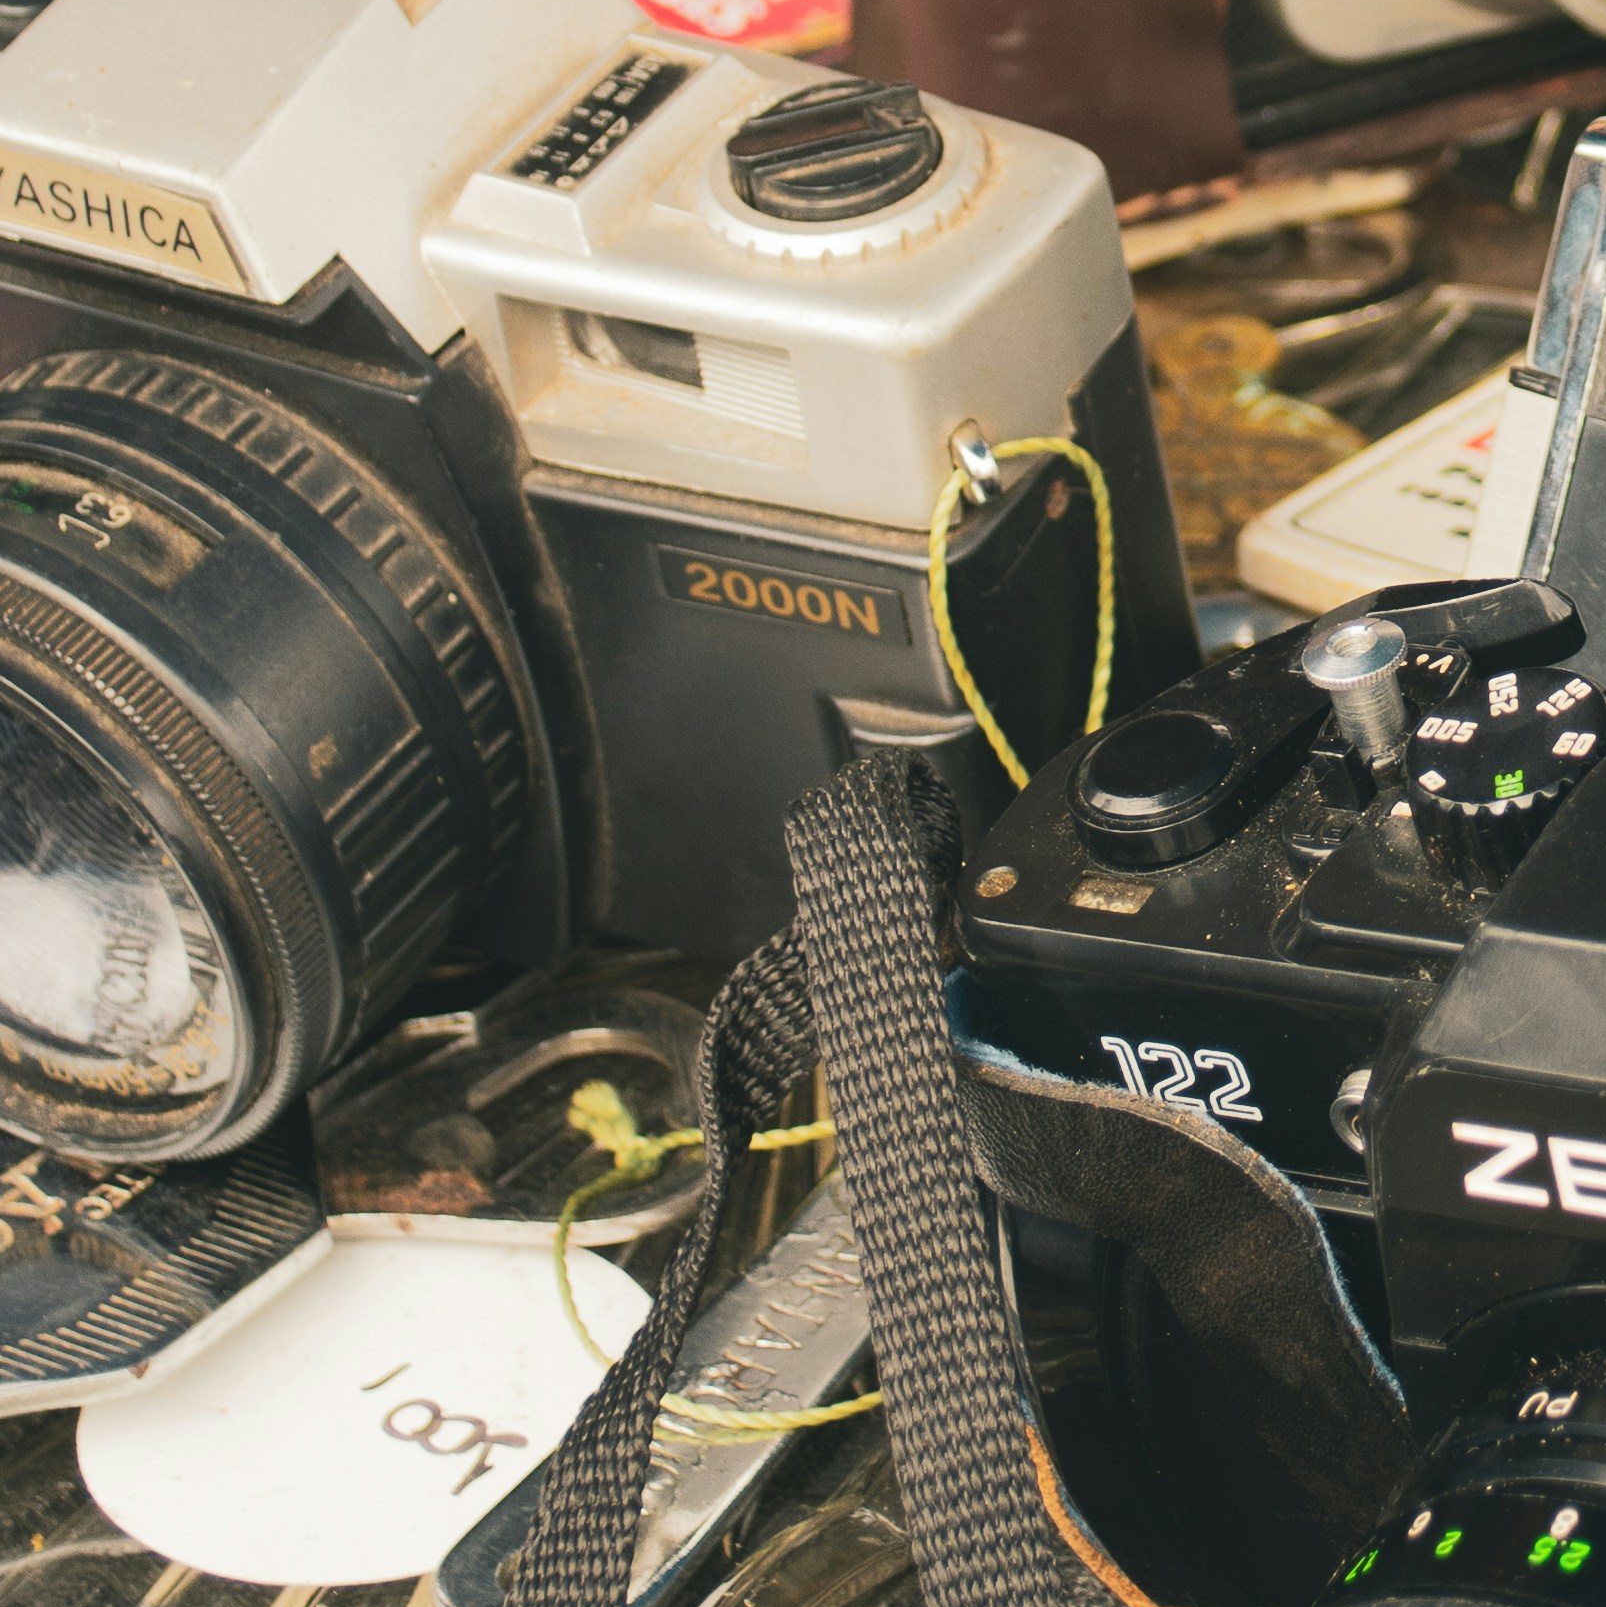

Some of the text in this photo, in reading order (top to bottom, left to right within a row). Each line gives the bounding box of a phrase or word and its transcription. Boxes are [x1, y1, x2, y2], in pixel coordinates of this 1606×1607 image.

[684, 561, 883, 639] 2000N
[1487, 672, 1519, 718] 250
[1536, 677, 1593, 718] 125
[1416, 715, 1479, 744] 500
[1551, 730, 1597, 758] 60
[1100, 1035, 1263, 1122] 122
[1406, 1510, 1434, 1539] 6
[1547, 1506, 1580, 1540] 8
[1434, 1529, 1464, 1560] 2
[1527, 1535, 1592, 1573] 2.5
